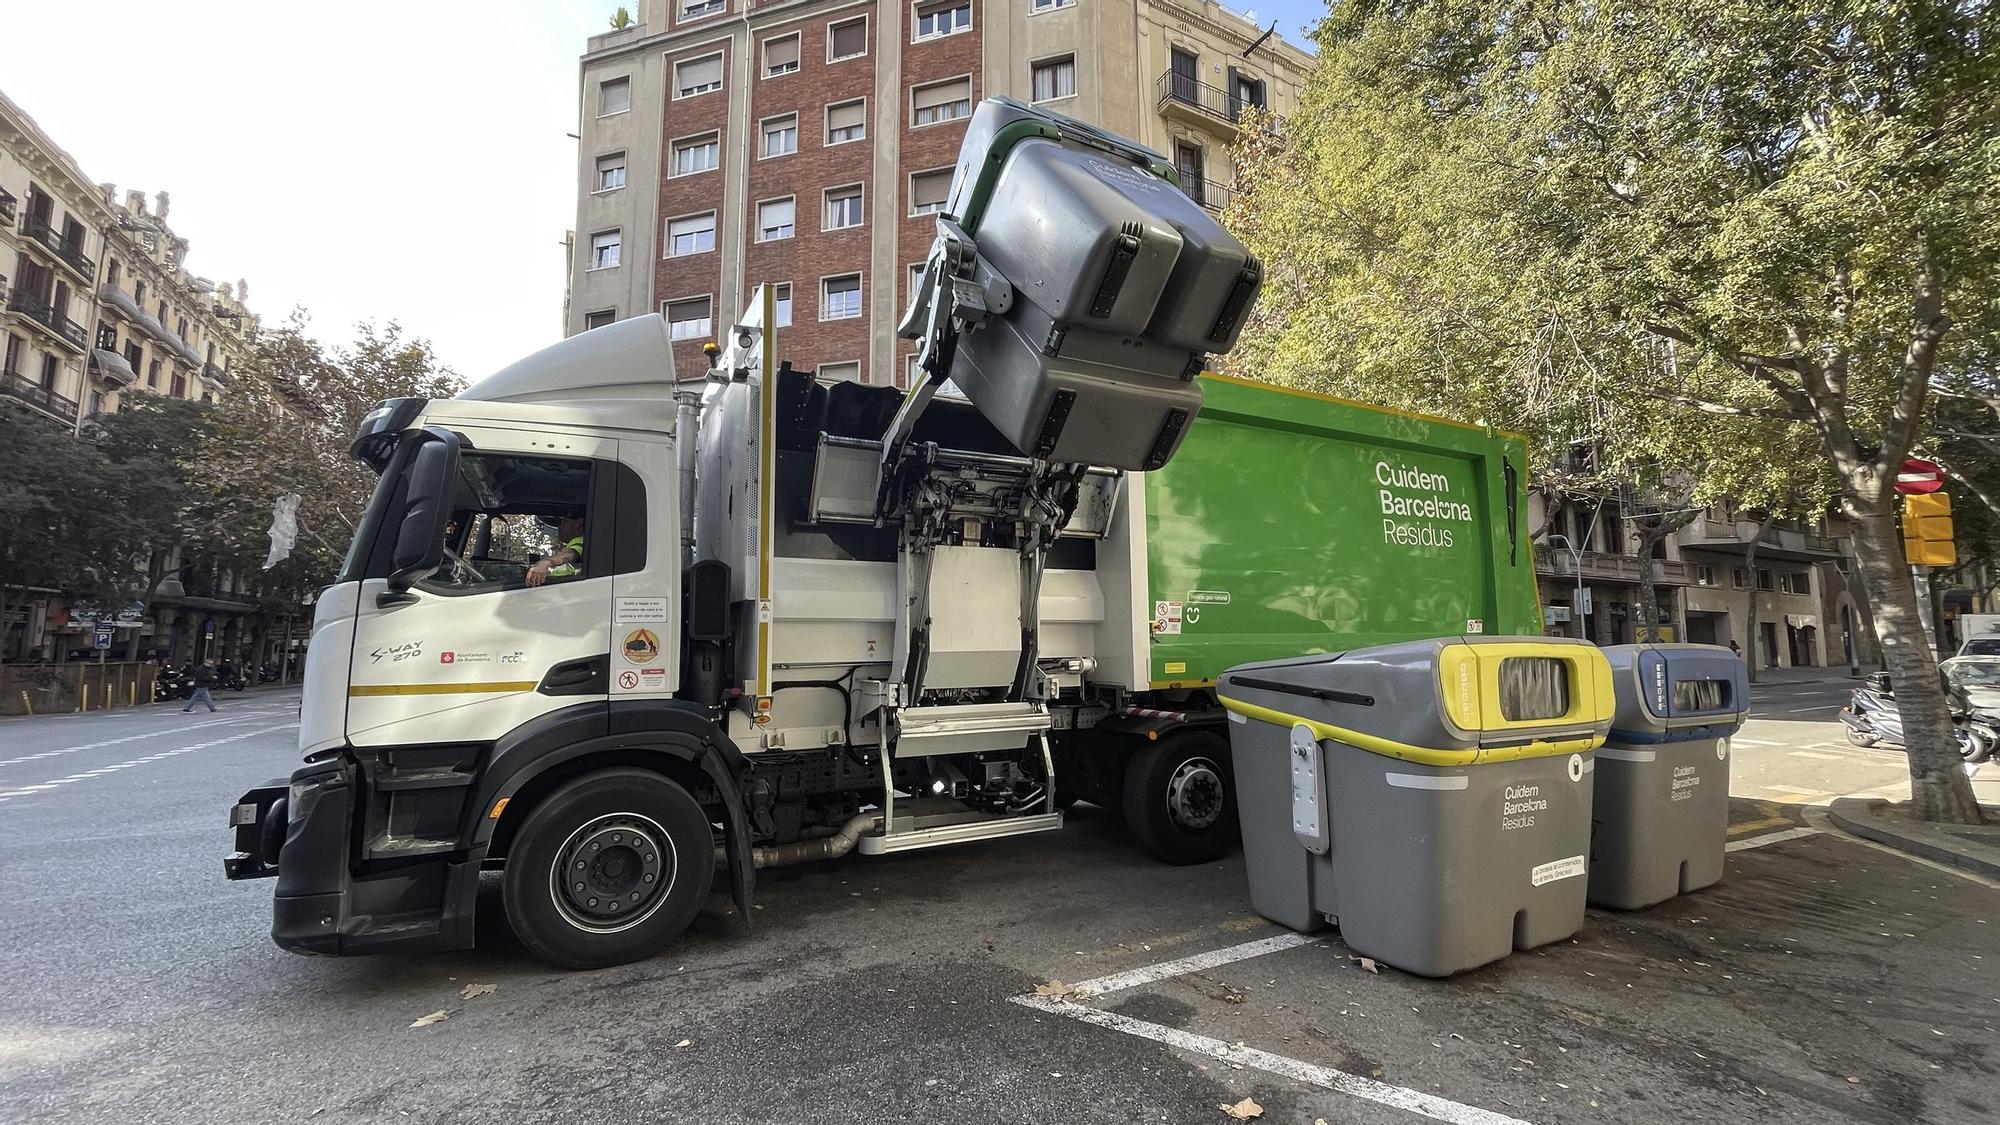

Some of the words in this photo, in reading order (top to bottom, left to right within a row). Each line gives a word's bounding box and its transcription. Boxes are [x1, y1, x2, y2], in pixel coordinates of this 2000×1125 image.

[1375, 461, 1449, 493] Cuidem
[1380, 489, 1472, 522] Barcelona
[1383, 518, 1453, 548] Residus
[99, 634, 107, 642] P
[370, 640, 424, 665] S-WAY
[393, 649, 422, 662] 270
[1673, 765, 1696, 778] Cuidem
[1504, 784, 1539, 800] Cuidem
[1503, 799, 1547, 815] Barcelona
[1501, 814, 1536, 832] Residus
